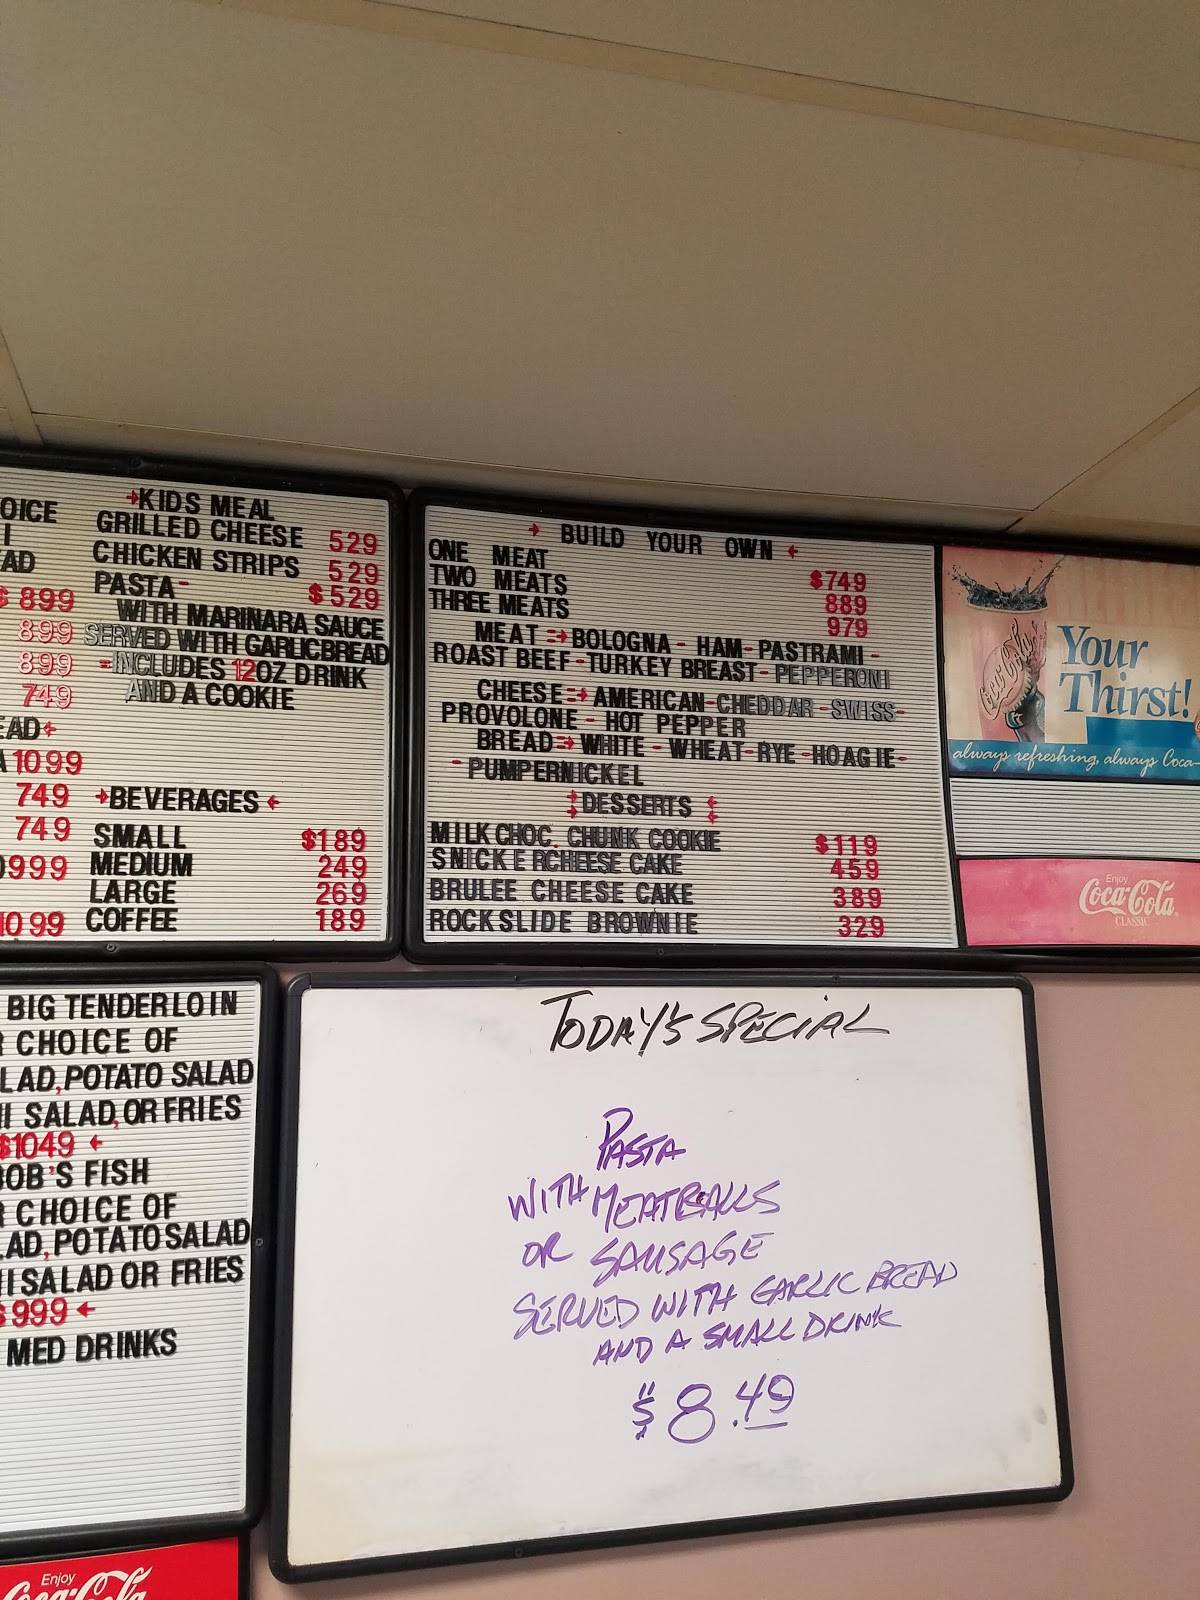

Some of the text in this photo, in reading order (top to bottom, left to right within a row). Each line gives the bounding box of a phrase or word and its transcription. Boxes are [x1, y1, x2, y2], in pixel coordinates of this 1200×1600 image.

[139, 488, 275, 521] KIDS MEAL
[97, 511, 378, 555] GRILLED CHEESE 529
[561, 523, 773, 560] BUILD YOUR OWN
[93, 540, 379, 585] CHICKEN STRIPS 529
[428, 538, 867, 593] ONE MEAT $749
[308, 583, 379, 610] $529
[429, 563, 868, 615] TWO MEATS 889
[117, 599, 384, 640] WITH MARINARA SAUCE
[428, 587, 868, 638] THREE MEATS 979
[18, 618, 73, 644] 899
[83, 623, 171, 653] SERVED
[178, 629, 237, 655] WITH
[475, 621, 539, 645] MEAT
[758, 639, 864, 665] PASTRAMI
[1057, 625, 1149, 669] Your
[18, 651, 73, 677] 899
[112, 651, 226, 680] INCLUDES
[295, 663, 367, 689] DRINK
[433, 641, 508, 667] ROAST
[516, 648, 571, 672] BEEF
[586, 652, 672, 677] TURKEY
[775, 663, 891, 690] PEPPERONI
[21, 683, 72, 709] 749
[125, 679, 294, 710] AND A COOKIE
[477, 679, 563, 705] CHEESE
[1059, 670, 1192, 718] Thirst!
[441, 701, 746, 739] PROVOLONE HOT PEPPER
[477, 728, 554, 753] BREAD
[580, 733, 645, 758] WHITE
[12, 749, 83, 775] 1099
[468, 757, 645, 786] PUMPERNICKEL
[953, 742, 1009, 772] always
[1104, 748, 1158, 777] always
[16, 782, 69, 808] 749
[109, 785, 259, 813] BEVERAGES
[582, 791, 692, 818] DESSERTS
[15, 816, 71, 841] 749
[93, 822, 366, 852] SMALL $189
[430, 821, 490, 845] MILK
[567, 826, 640, 849] CHUNK
[649, 828, 721, 852] COOKIE
[815, 833, 878, 856] $119
[8, 854, 68, 881] 999
[89, 851, 367, 879] MEDIUM 249
[630, 853, 683, 876] CAKE
[831, 858, 879, 880] 459
[1106, 874, 1128, 885] Enjoy
[89, 879, 367, 905] LARGE 269
[430, 878, 882, 909] BRULEE CHEESE CAKE 389
[1079, 878, 1175, 916] Coca-Cola
[86, 907, 366, 932] COFFEE 189
[587, 911, 698, 934] BROWNIE
[838, 915, 885, 938] 329
[1115, 917, 1151, 927] CLASSIC
[7, 991, 238, 1021] BIG TENDERLOIN
[696, 996, 890, 1044] SPECIAL
[17, 1028, 130, 1056] CHOICE
[145, 1027, 178, 1053] OF
[64, 1062, 163, 1091] POTATO
[171, 1059, 254, 1087] SALAD
[124, 1098, 157, 1124] OR
[164, 1094, 242, 1123] FRIES
[596, 1107, 686, 1171] PASTA
[0, 1157, 149, 1190] OB'S FISH
[16, 1195, 131, 1226] CHOICE
[143, 1192, 177, 1219] OF
[508, 1173, 781, 1232] WITH MEATBALLS
[53, 1224, 161, 1256] POTATO
[165, 1218, 250, 1249] SALAD
[522, 1230, 774, 1287] OR SAUSAGE
[21, 1263, 113, 1296] SALAD
[121, 1260, 158, 1289] OR
[171, 1255, 244, 1287] FRIES
[512, 1259, 959, 1340] SERVED WITH GARLIC BREAD
[7, 1328, 178, 1367] MED DRINKS
[592, 1304, 903, 1366] AND A SMALL DRINK
[41, 1572, 76, 1587] Enjoy
